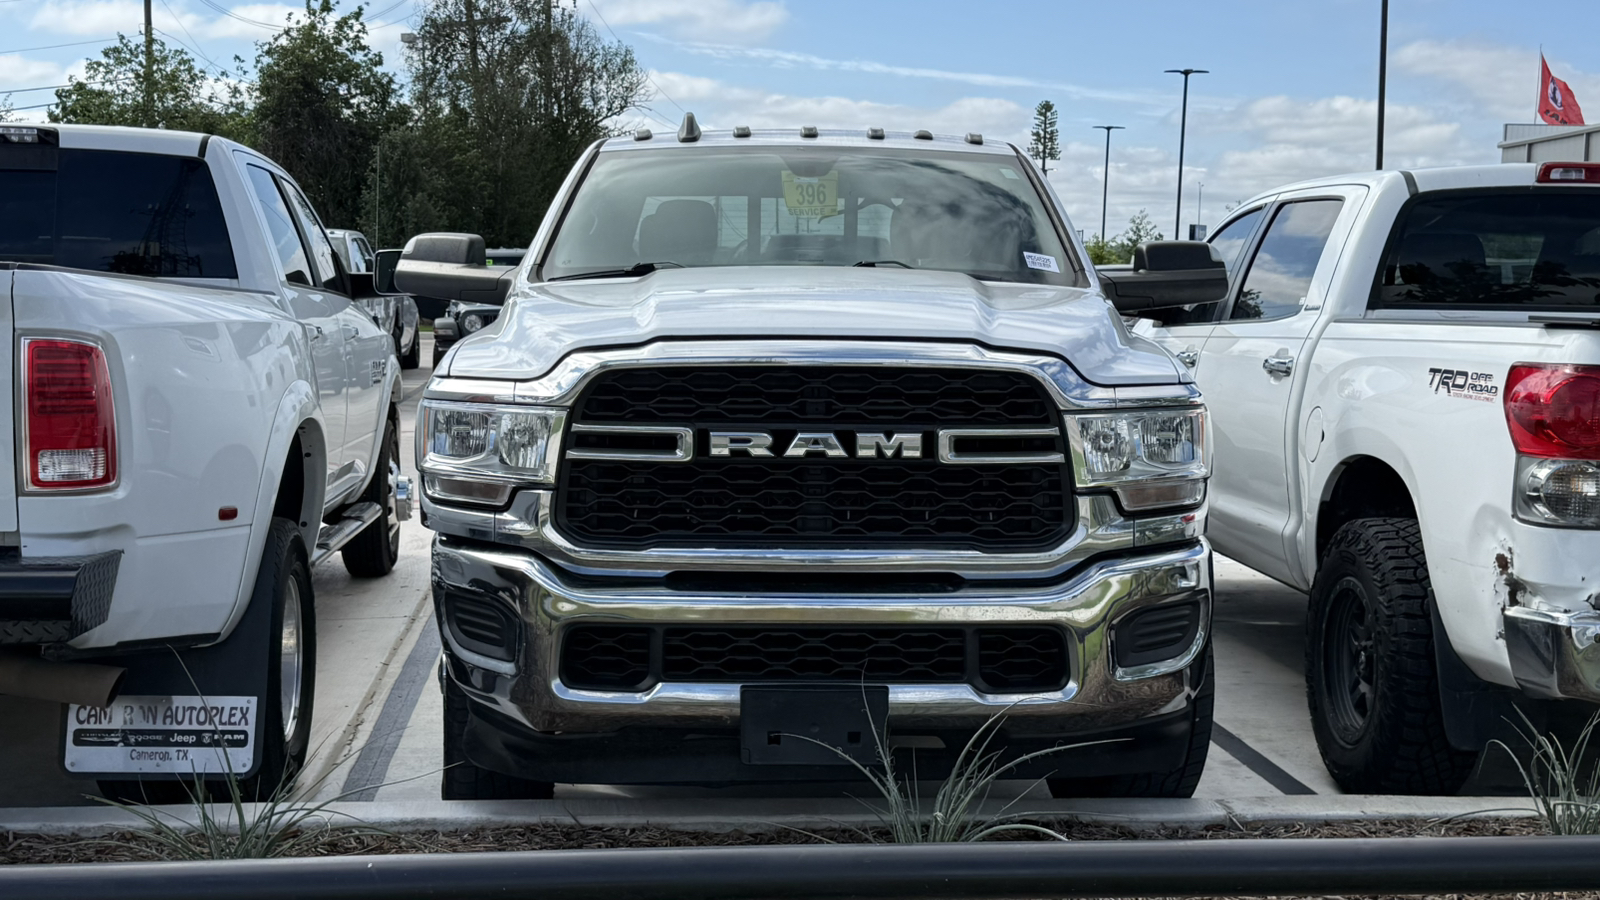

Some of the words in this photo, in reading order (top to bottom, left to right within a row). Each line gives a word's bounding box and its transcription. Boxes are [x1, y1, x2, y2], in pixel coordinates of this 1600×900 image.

[796, 183, 827, 206] 396
[788, 208, 826, 216] SERVICE
[1428, 367, 1469, 395] TRD
[1470, 371, 1494, 382] OFF
[1467, 383, 1498, 396] ROAD
[709, 431, 923, 457] RAM
[162, 705, 250, 726] AUTOPLEX
[169, 732, 197, 744] Jeep
[175, 749, 189, 761] TX
